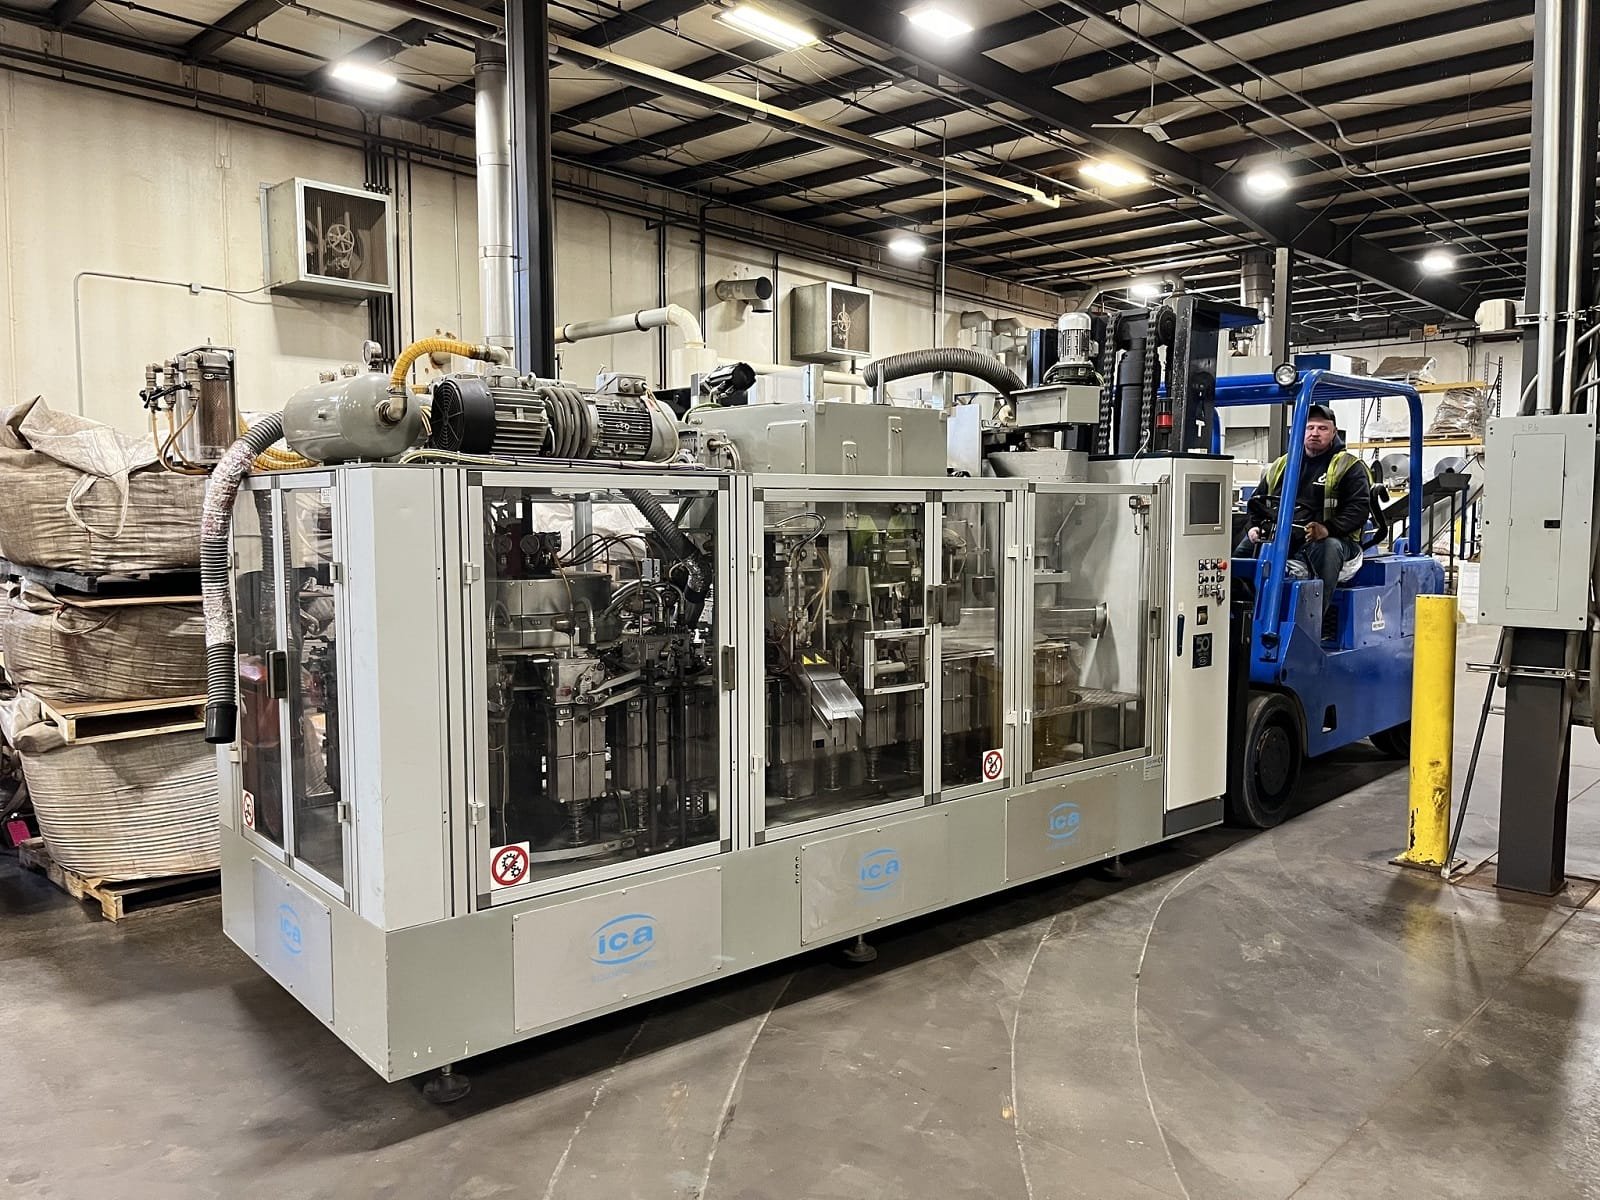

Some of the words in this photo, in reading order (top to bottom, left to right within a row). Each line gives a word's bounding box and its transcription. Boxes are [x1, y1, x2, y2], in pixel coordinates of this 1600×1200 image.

[1050, 811, 1080, 831] ica
[860, 859, 900, 881] ica
[598, 925, 654, 955] ica
